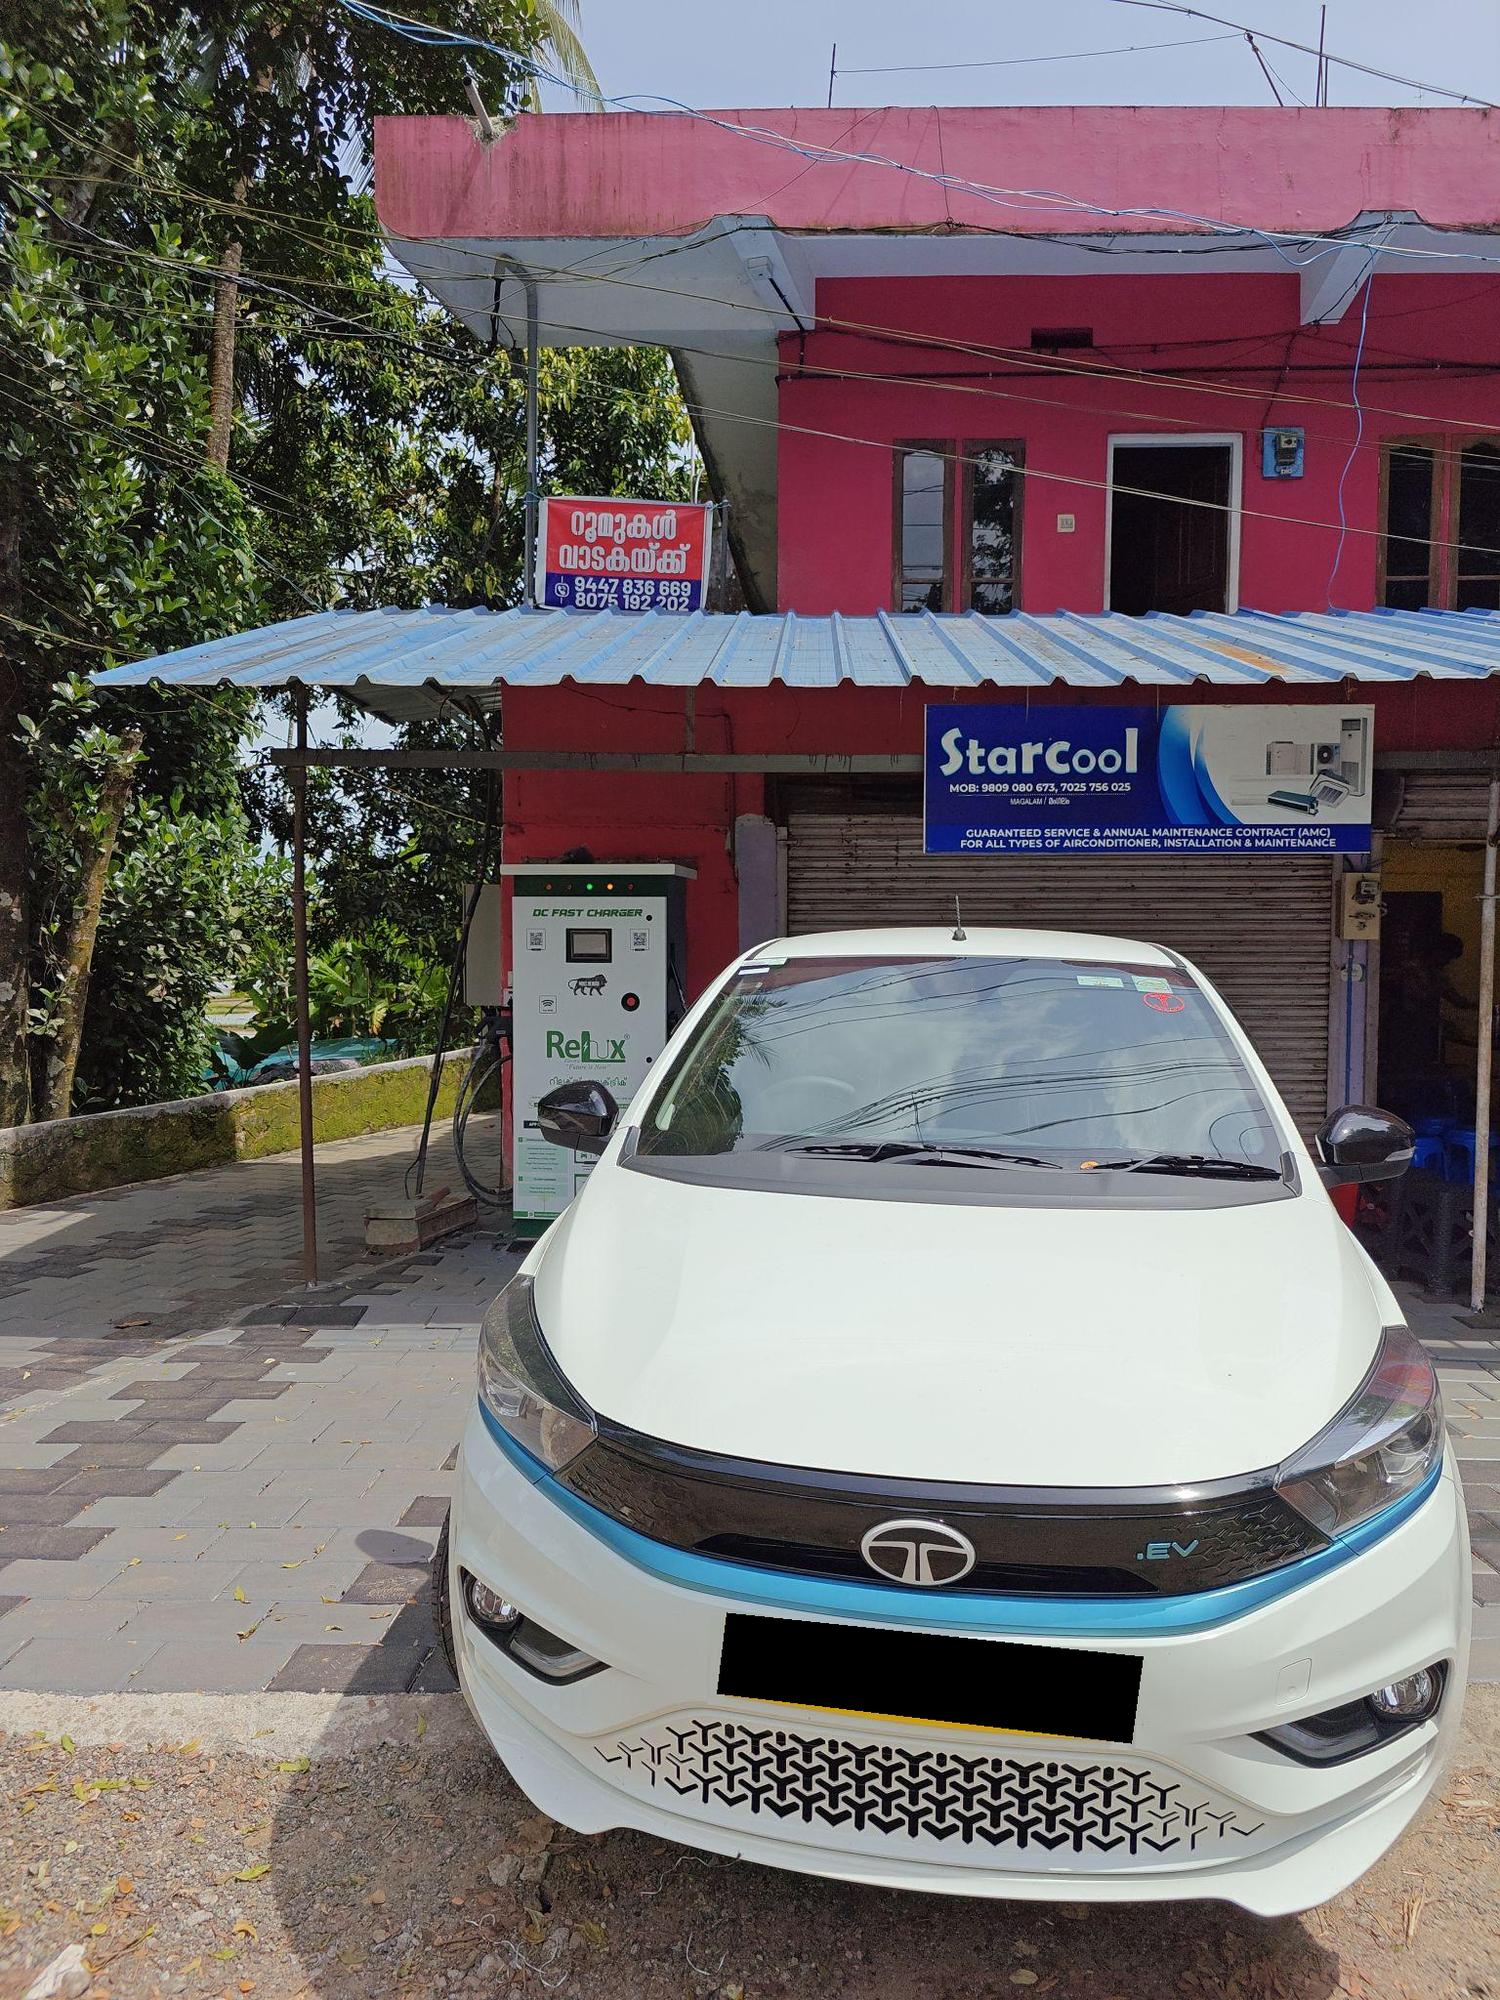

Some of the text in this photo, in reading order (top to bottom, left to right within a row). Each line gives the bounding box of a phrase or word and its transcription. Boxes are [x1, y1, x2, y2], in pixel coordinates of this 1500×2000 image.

[574, 576, 692, 597] 9447 836 669
[574, 592, 690, 612] 8075 192 202
[949, 782, 1132, 794] MOB: 9809 080 673, 7025 756 025
[966, 827, 1331, 838] GUARANTEED SERVICE & ANNUAL MAINTENANCE CONTRACT (AMC)
[960, 838, 1337, 849] FOR ALL TYPES OF AIRCONDITIONER, INSTALLATION & MAINTENANCE
[533, 909, 644, 917] DC FAST CHARGER
